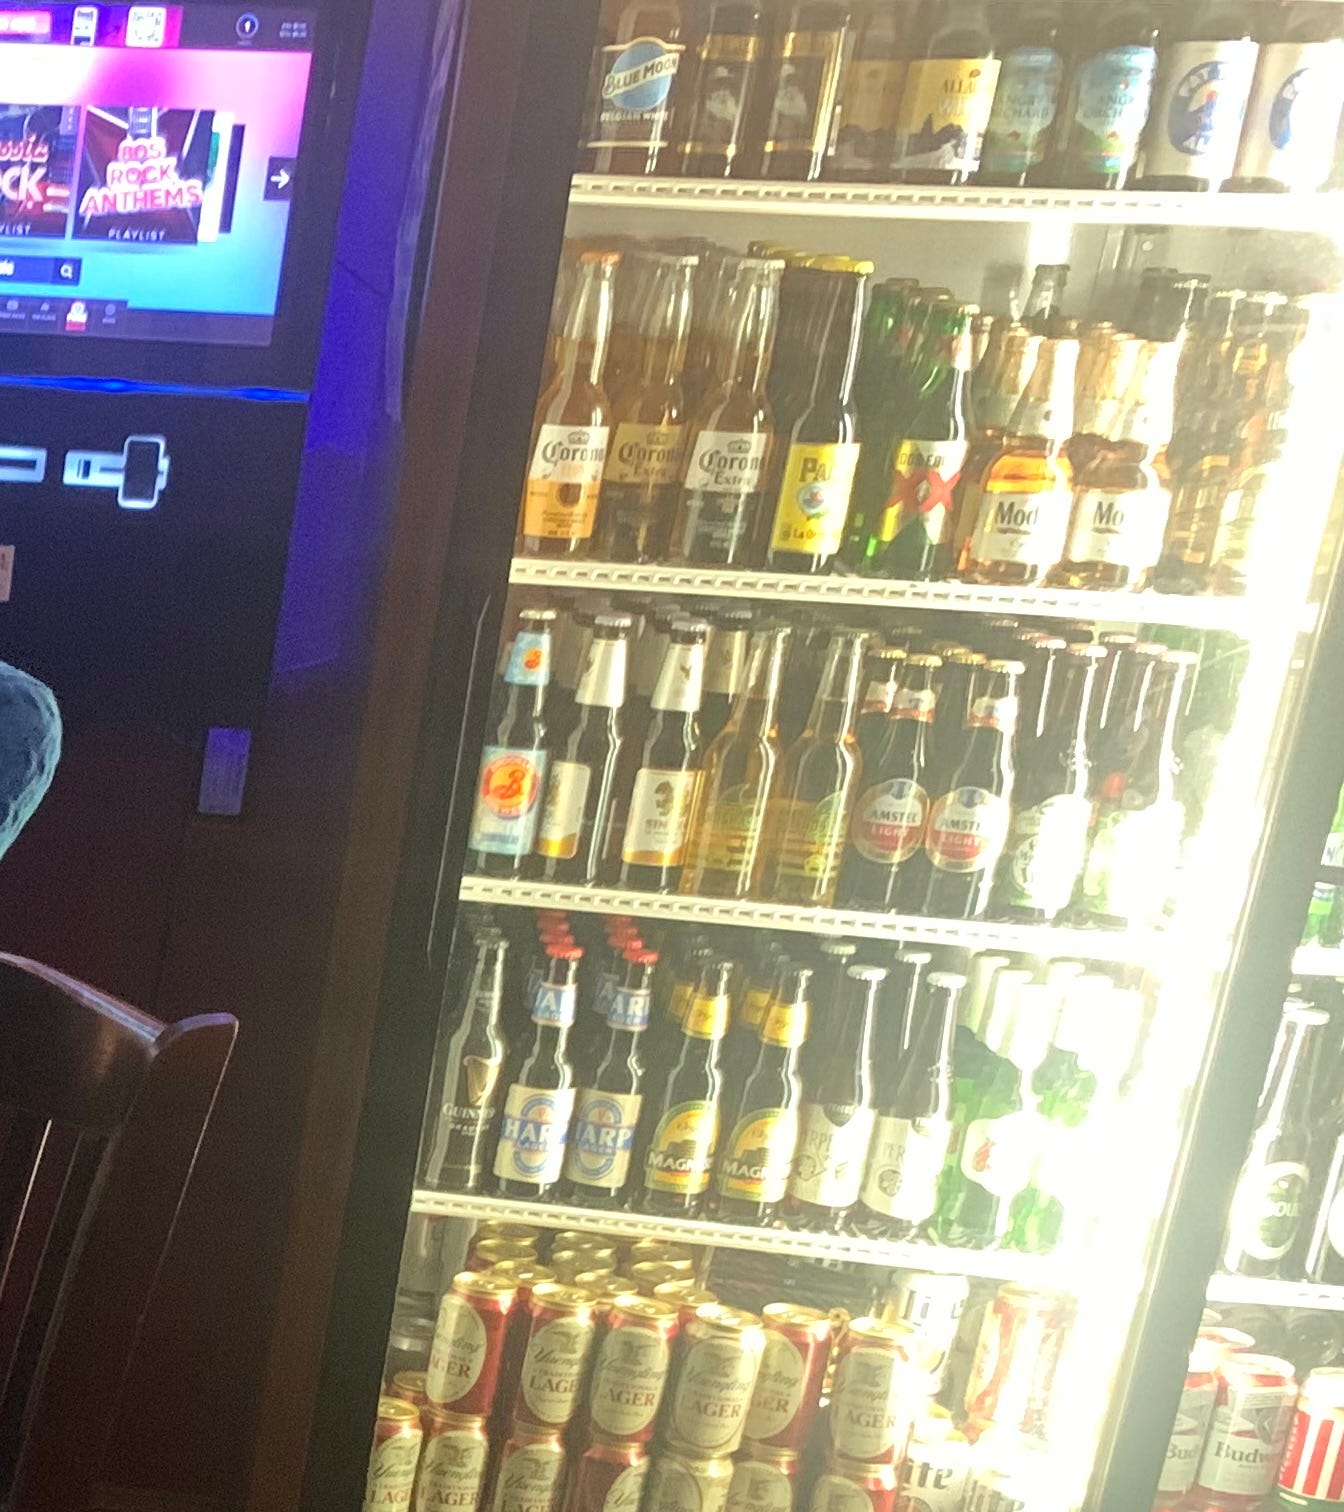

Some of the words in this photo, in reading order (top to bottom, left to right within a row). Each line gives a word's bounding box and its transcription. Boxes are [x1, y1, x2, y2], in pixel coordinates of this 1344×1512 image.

[604, 69, 640, 95] BLUE
[111, 164, 172, 185] ROCK
[82, 185, 202, 215] ANTHEMS
[107, 228, 166, 241] PLAYLIST
[504, 1118, 553, 1143] HAR
[648, 1151, 713, 1171] MAGNS
[721, 1159, 766, 1178] MAG
[608, 1387, 656, 1407] AGER
[695, 1402, 742, 1419] AGER
[905, 1457, 953, 1490] ite
